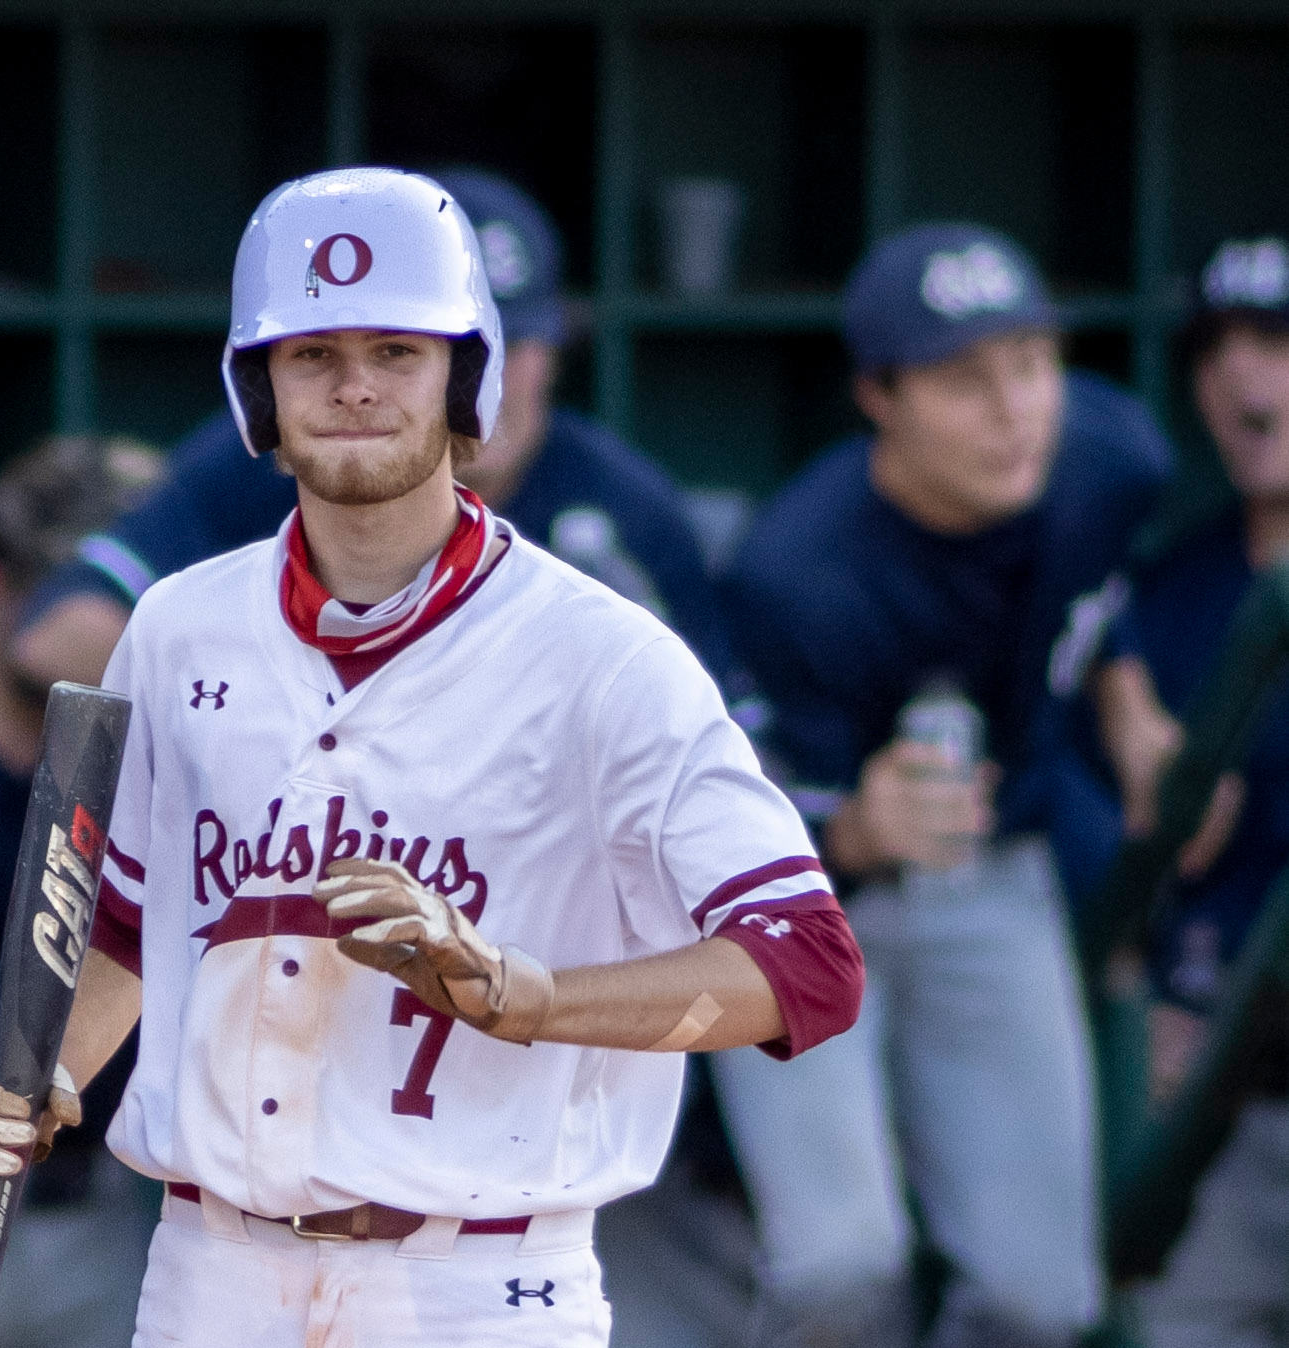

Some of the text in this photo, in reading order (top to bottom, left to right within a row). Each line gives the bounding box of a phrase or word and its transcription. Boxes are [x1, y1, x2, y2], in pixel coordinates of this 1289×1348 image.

[313, 232, 373, 287] O
[194, 796, 487, 905] Redskins
[389, 986, 456, 1120] 7
